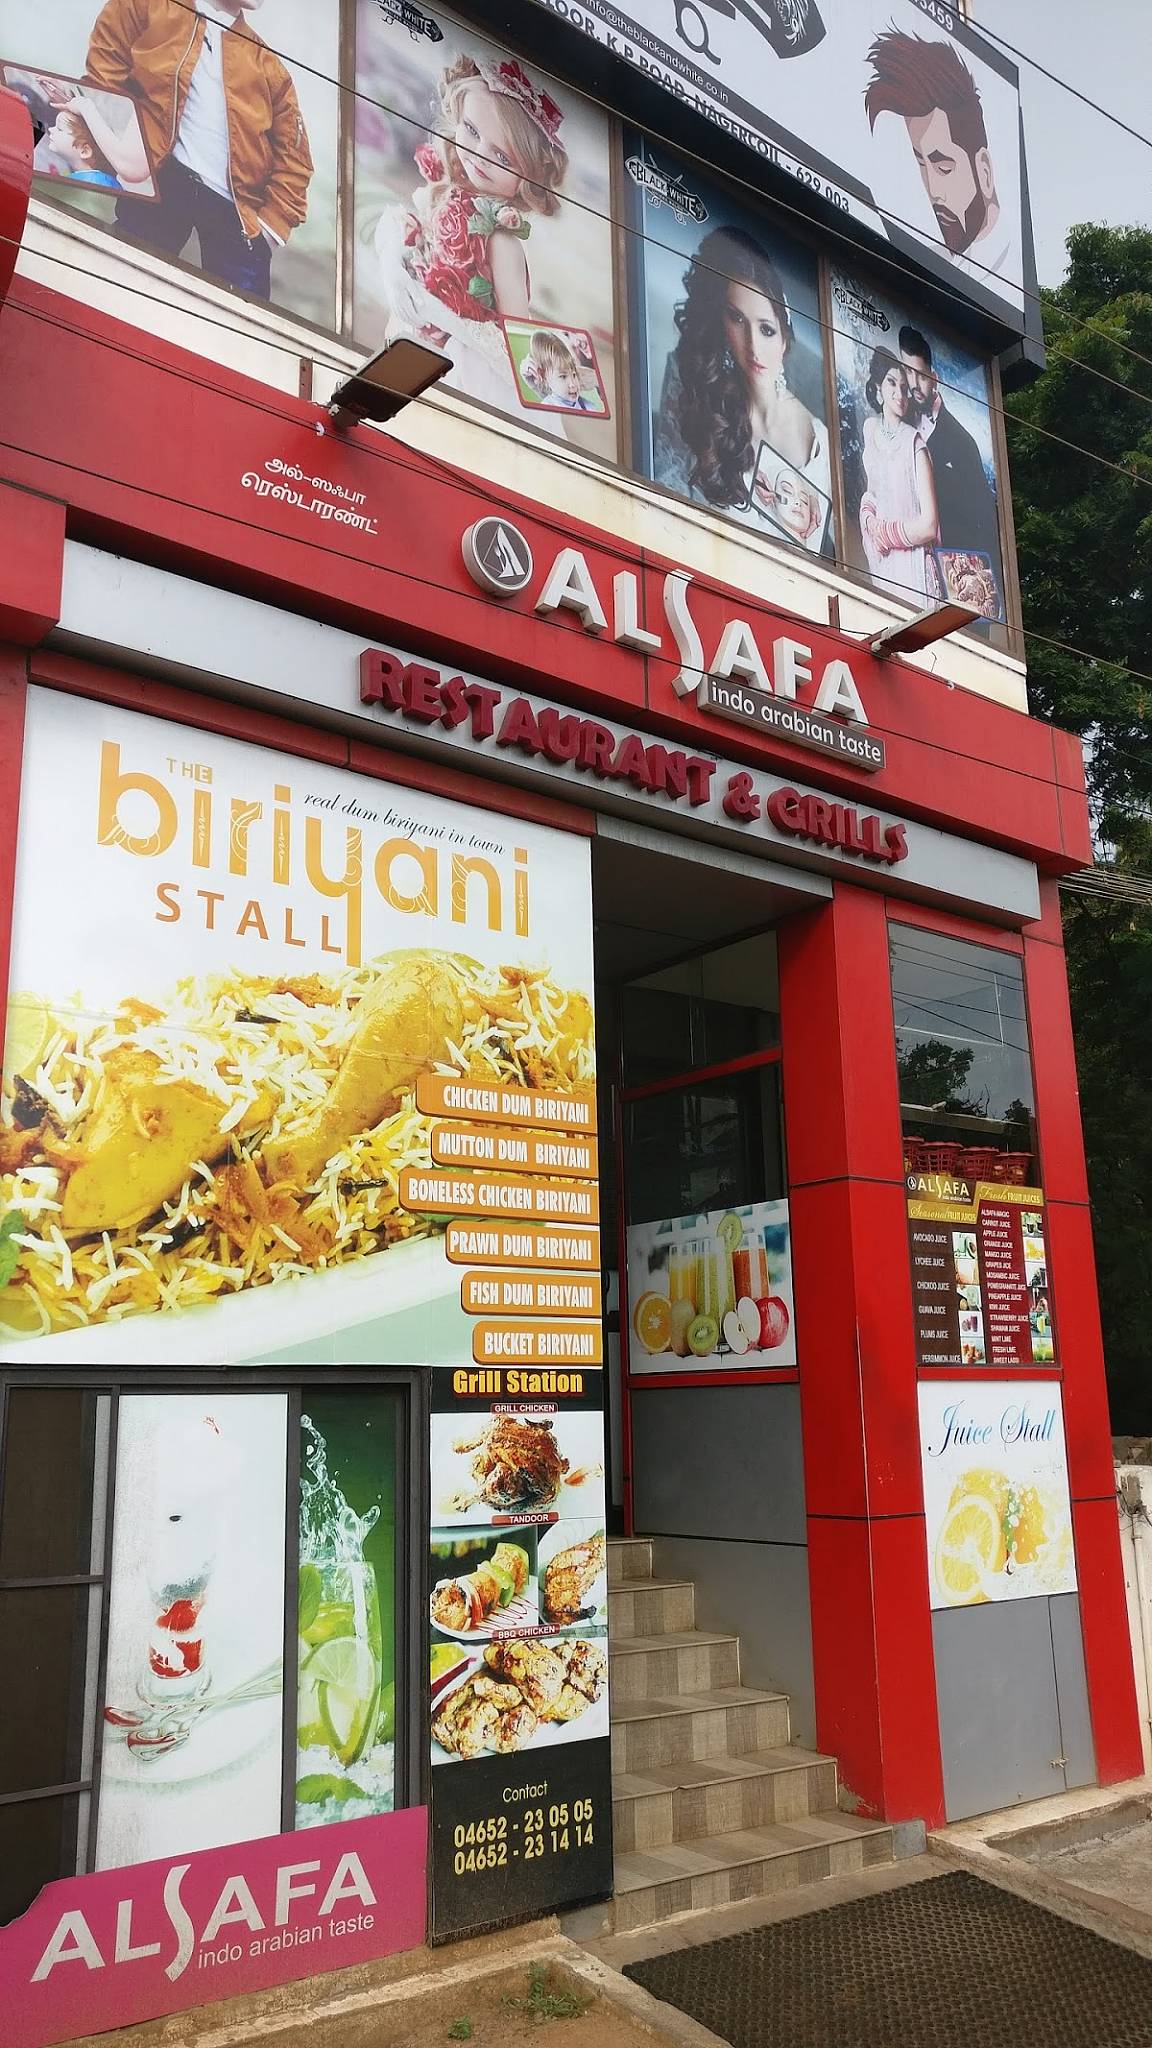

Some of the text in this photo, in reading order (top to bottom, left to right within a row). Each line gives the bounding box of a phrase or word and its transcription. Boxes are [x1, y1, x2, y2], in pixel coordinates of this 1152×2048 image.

[404, 9, 431, 37] WHITE
[669, 187, 697, 216] WHITE
[796, 167, 821, 192] 629
[826, 186, 850, 214] 003
[712, 682, 881, 762] indo arabian taste
[166, 757, 213, 785] THE
[359, 647, 908, 866] RESTAURANT & GRILLS
[304, 794, 506, 855] real dum biriyani in town
[97, 740, 530, 968] biriyani
[155, 882, 342, 955] STALL
[444, 1085, 589, 1124] CHICKEN DUM BIRIYANI
[439, 1132, 590, 1168] MUTTON DUM BIRIYANI
[408, 1177, 591, 1214] BONELESS CHICKEN BIRIYANI
[449, 1230, 592, 1261] PRAWN DUM BIRIYANI
[470, 1281, 593, 1308] FISH DUM BIRIYANI
[484, 1332, 594, 1356] BUCKET BIRIYANI
[453, 1369, 583, 1394] Grill Station
[494, 1403, 555, 1412] GRILL CHICKEN
[928, 1399, 1056, 1457] Juice Stall
[509, 1514, 549, 1523] TANDOOR
[498, 1625, 555, 1639] BBQ CHICKEN
[503, 1780, 548, 1803] Contact
[454, 1816, 508, 1848] 04652
[524, 1809, 544, 1833] 23
[550, 1803, 569, 1828] 05
[573, 1798, 594, 1822] 05
[454, 1842, 508, 1876] 04652
[524, 1834, 544, 1859] 23
[550, 1828, 570, 1852] 14
[575, 1823, 594, 1847] 14
[198, 1913, 375, 1969] indo arabian taste
